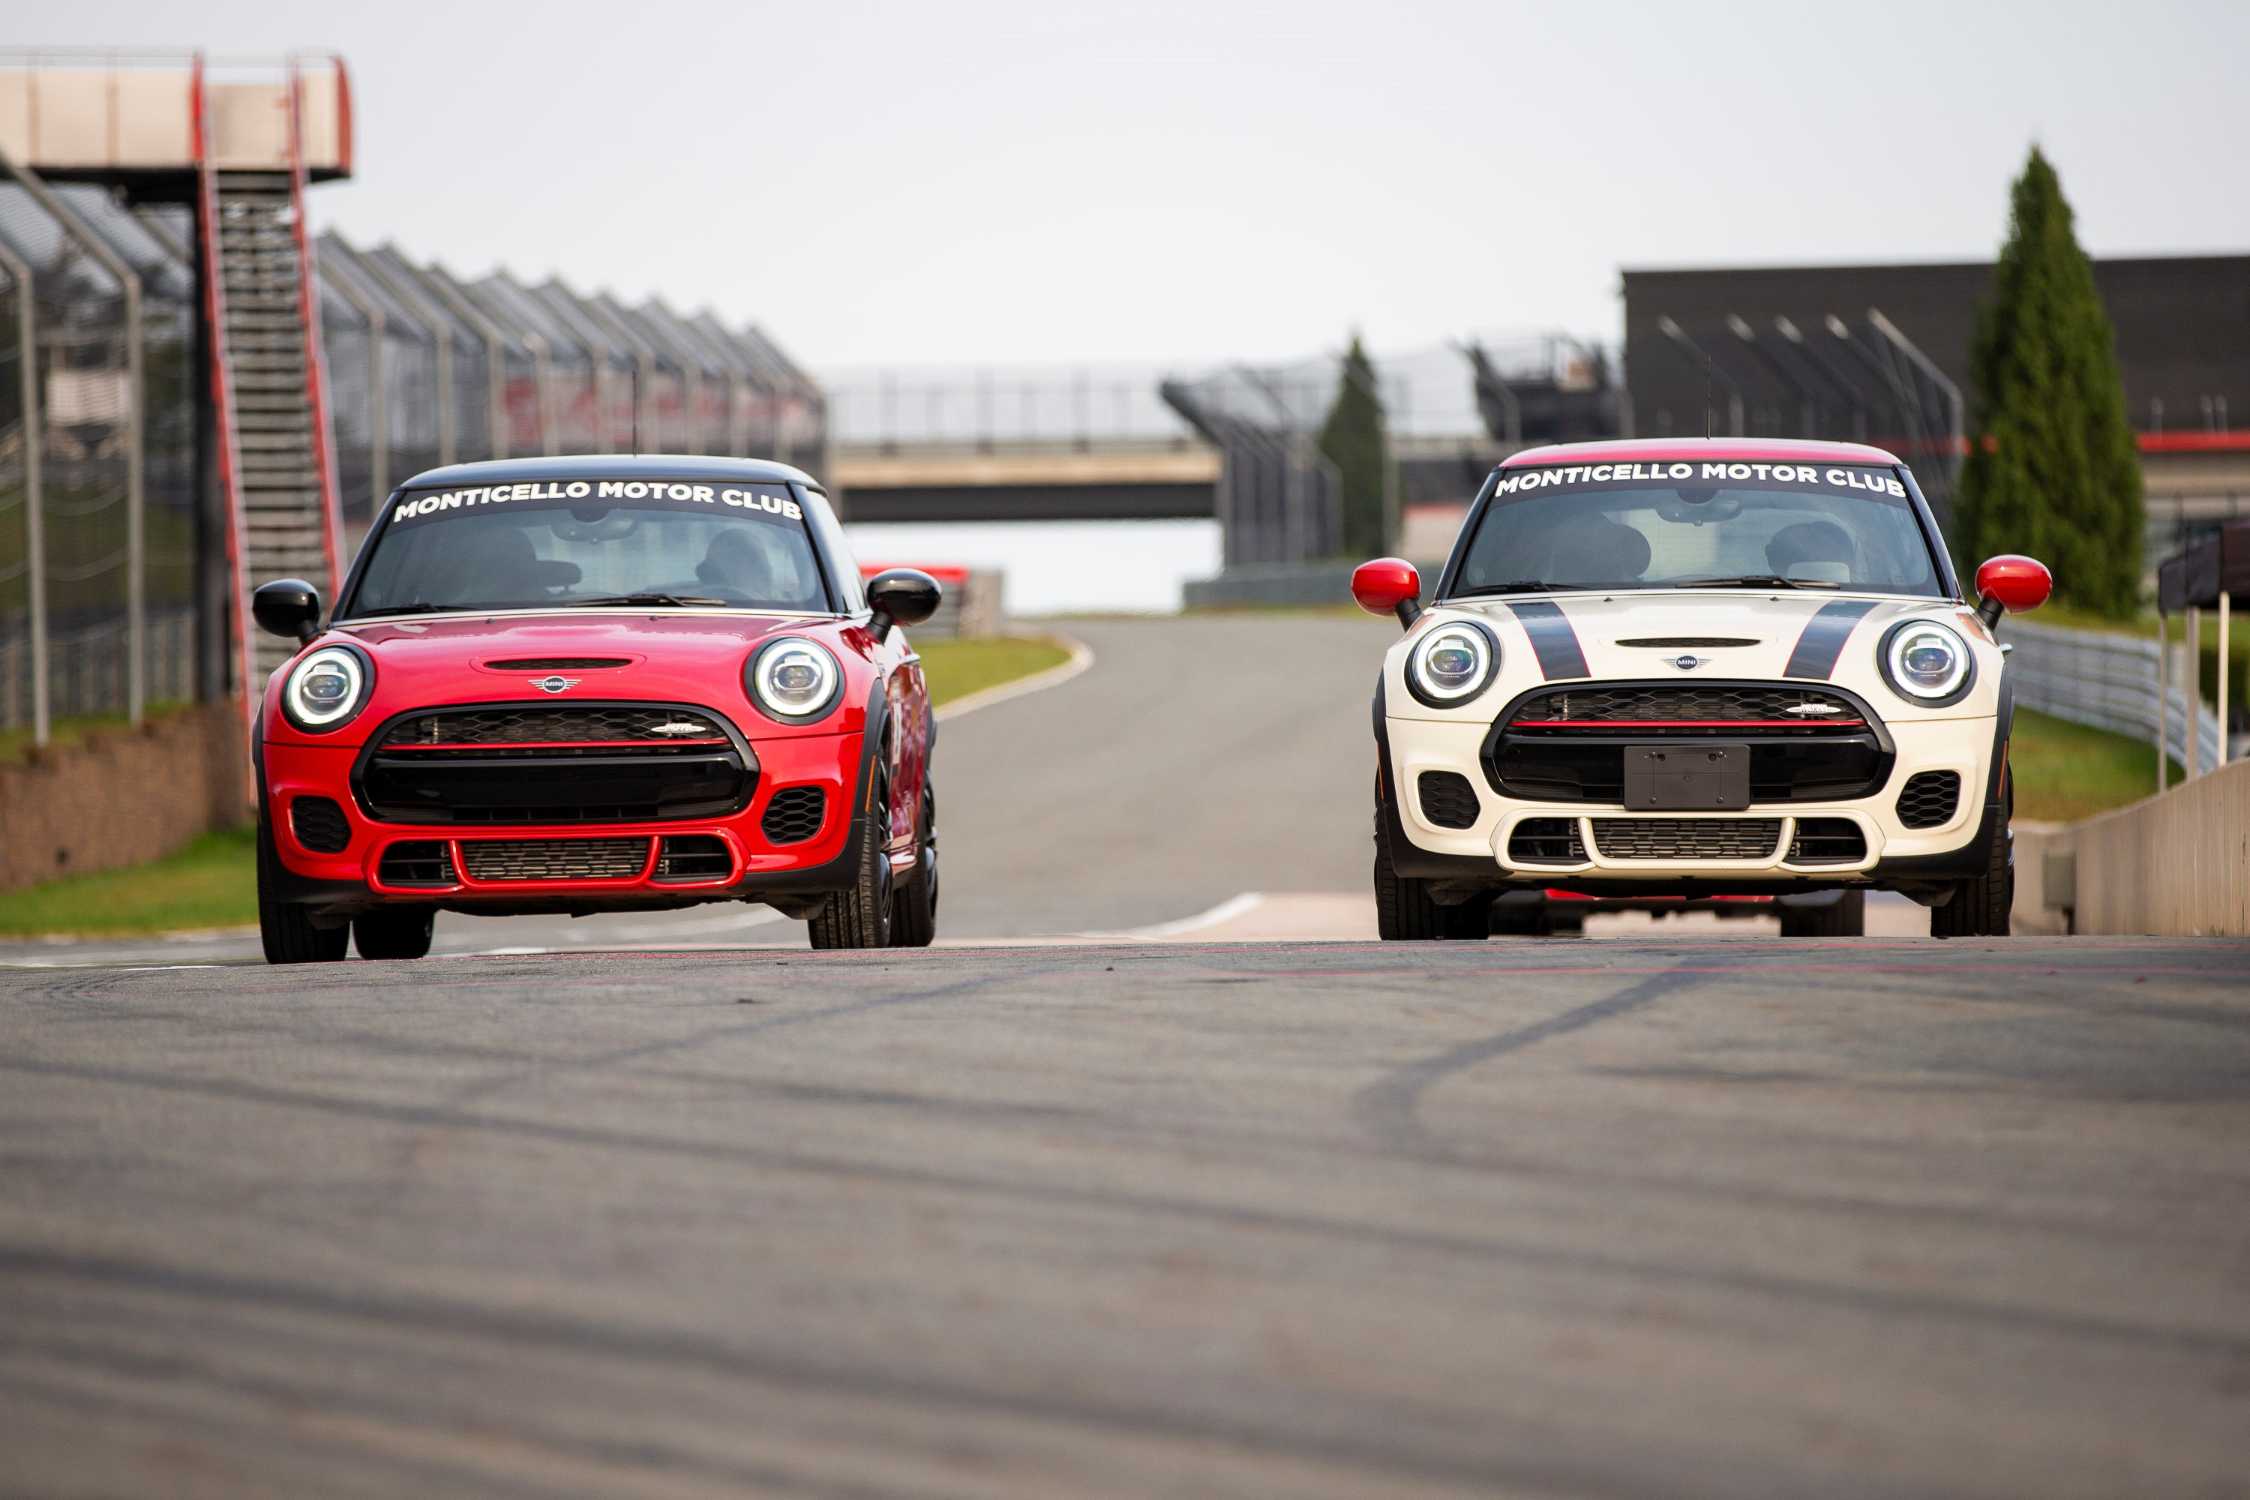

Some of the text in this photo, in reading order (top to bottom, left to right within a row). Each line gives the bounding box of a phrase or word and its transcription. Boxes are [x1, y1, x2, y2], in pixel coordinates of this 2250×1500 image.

[1495, 463, 1906, 498] MONTICELLO MOTOR CLUB
[394, 482, 801, 522] MONTICELLO MOTOR CLUB
